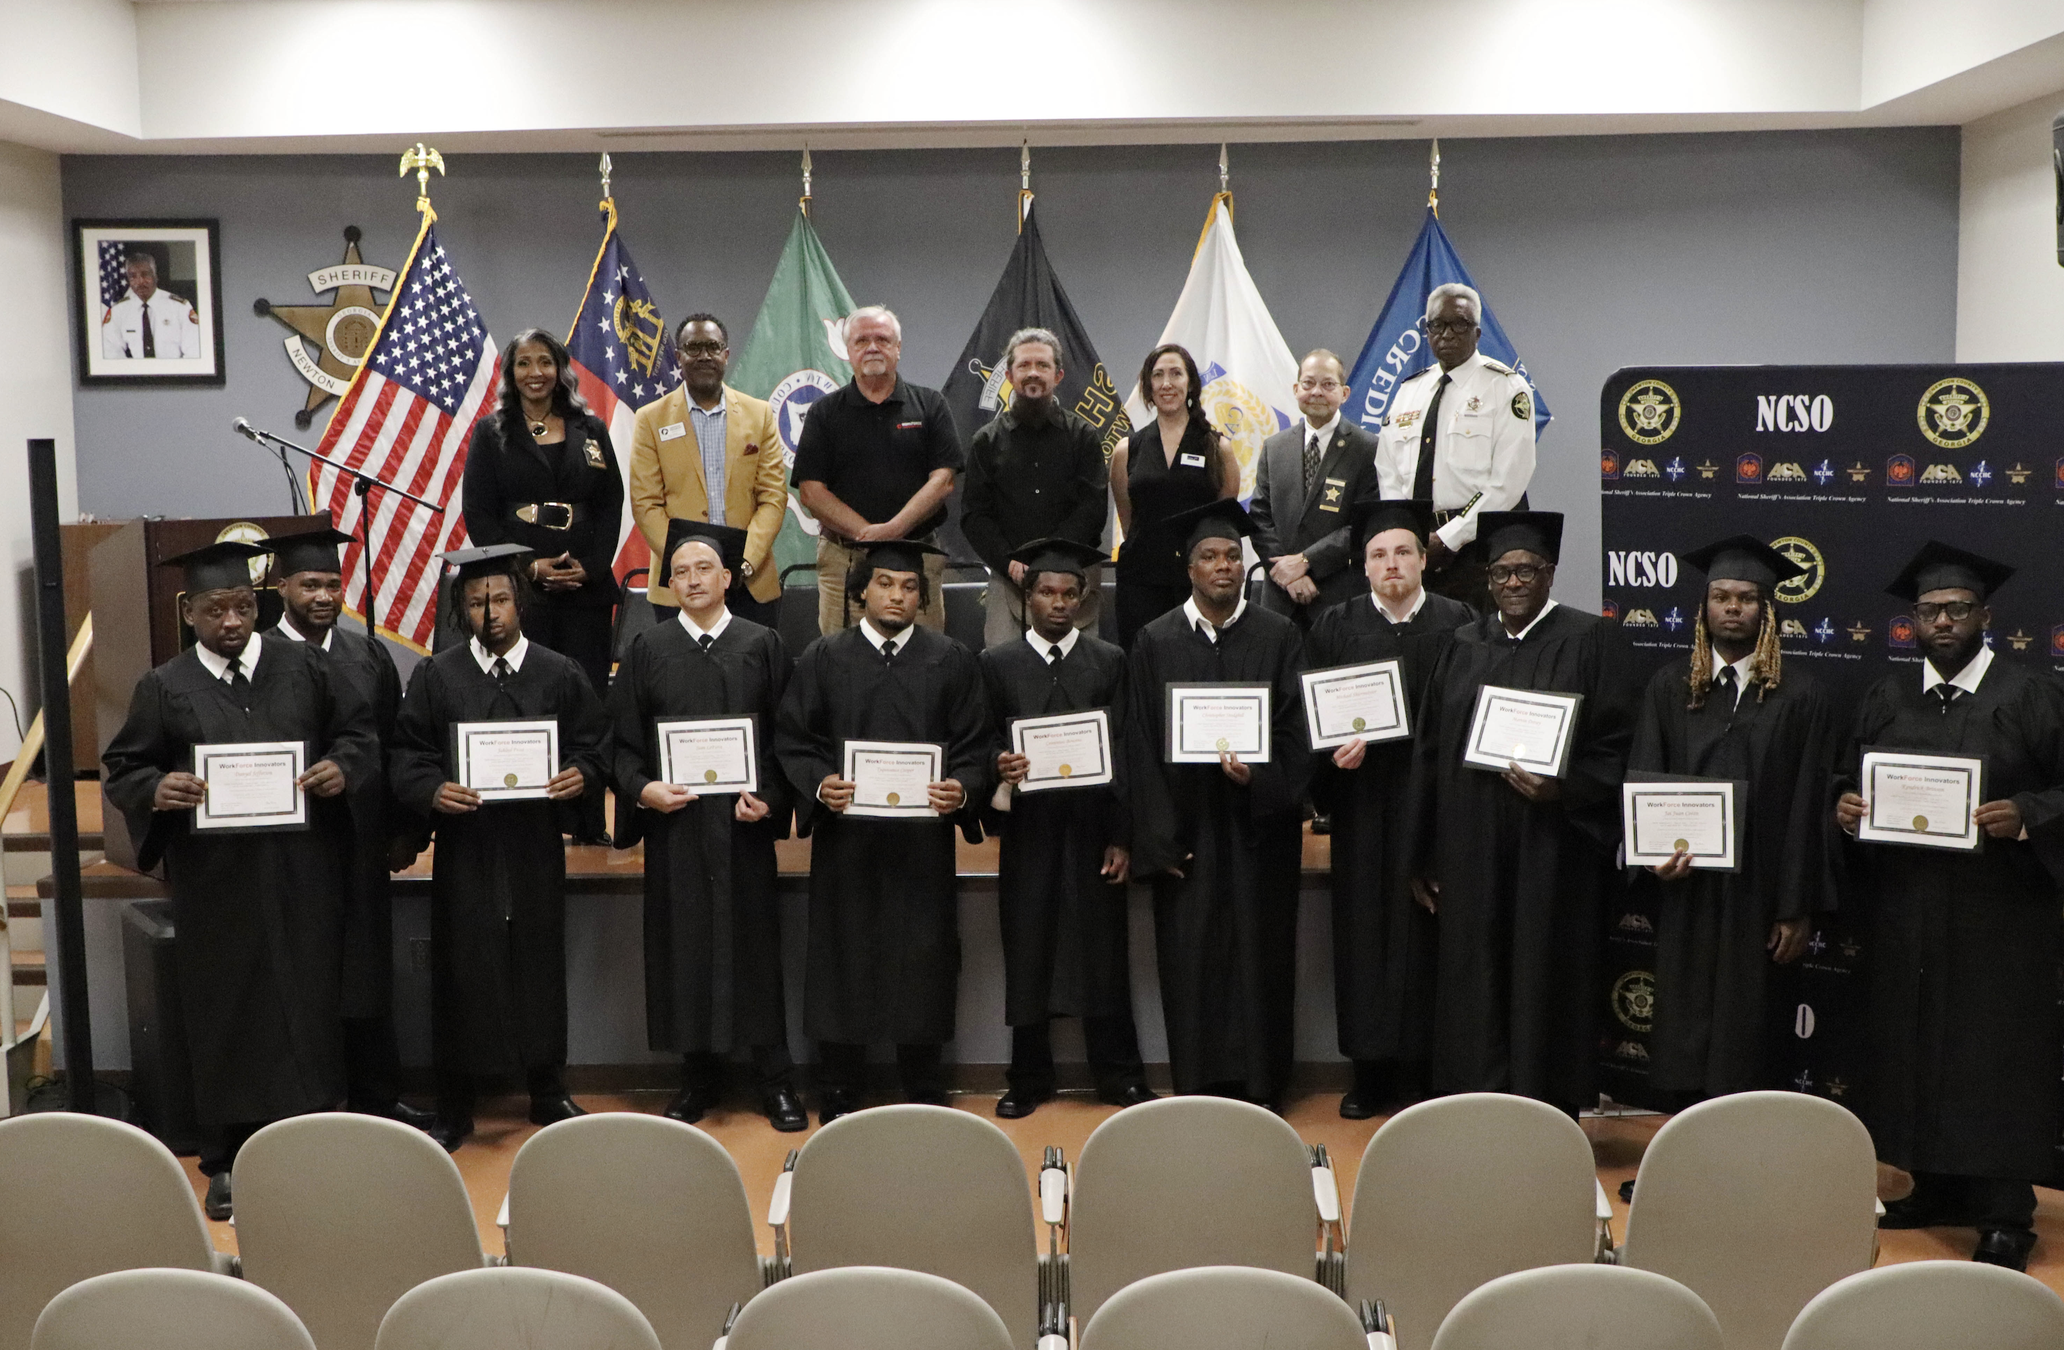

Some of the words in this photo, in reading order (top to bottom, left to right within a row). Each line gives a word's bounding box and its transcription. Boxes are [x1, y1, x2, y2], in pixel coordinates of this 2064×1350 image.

[317, 269, 390, 286] SHERIFF
[337, 307, 372, 319] GEORGIA
[291, 347, 336, 390] NEWTON
[1930, 379, 1955, 391] NEWTON
[1956, 379, 1978, 391] COUNTY
[1755, 394, 1834, 433] NCSO
[1631, 434, 1667, 444] GEORGIA
[1932, 437, 1972, 447] GEORGIA
[1623, 458, 1660, 475] ACA
[1767, 461, 1807, 478] ACA
[1920, 463, 1962, 481] ACA
[1760, 493, 1782, 501] Sheriff's
[1911, 496, 1935, 505] Sheriff's
[1607, 550, 1679, 588] NCSO
[1622, 608, 1659, 624] ACA
[1781, 619, 1808, 635] CA
[1659, 641, 1672, 649] Triple
[1809, 650, 1823, 658] Triple
[1843, 652, 1862, 660] Agency
[1324, 686, 1354, 694] WorkForce
[1355, 681, 1384, 689] Innovators
[1499, 706, 1528, 715] WorkForce
[1529, 711, 1557, 720] Innovators
[1063, 729, 1092, 737] Innovators
[1886, 774, 1923, 782] WorkForce
[1924, 776, 1960, 785] Innovators
